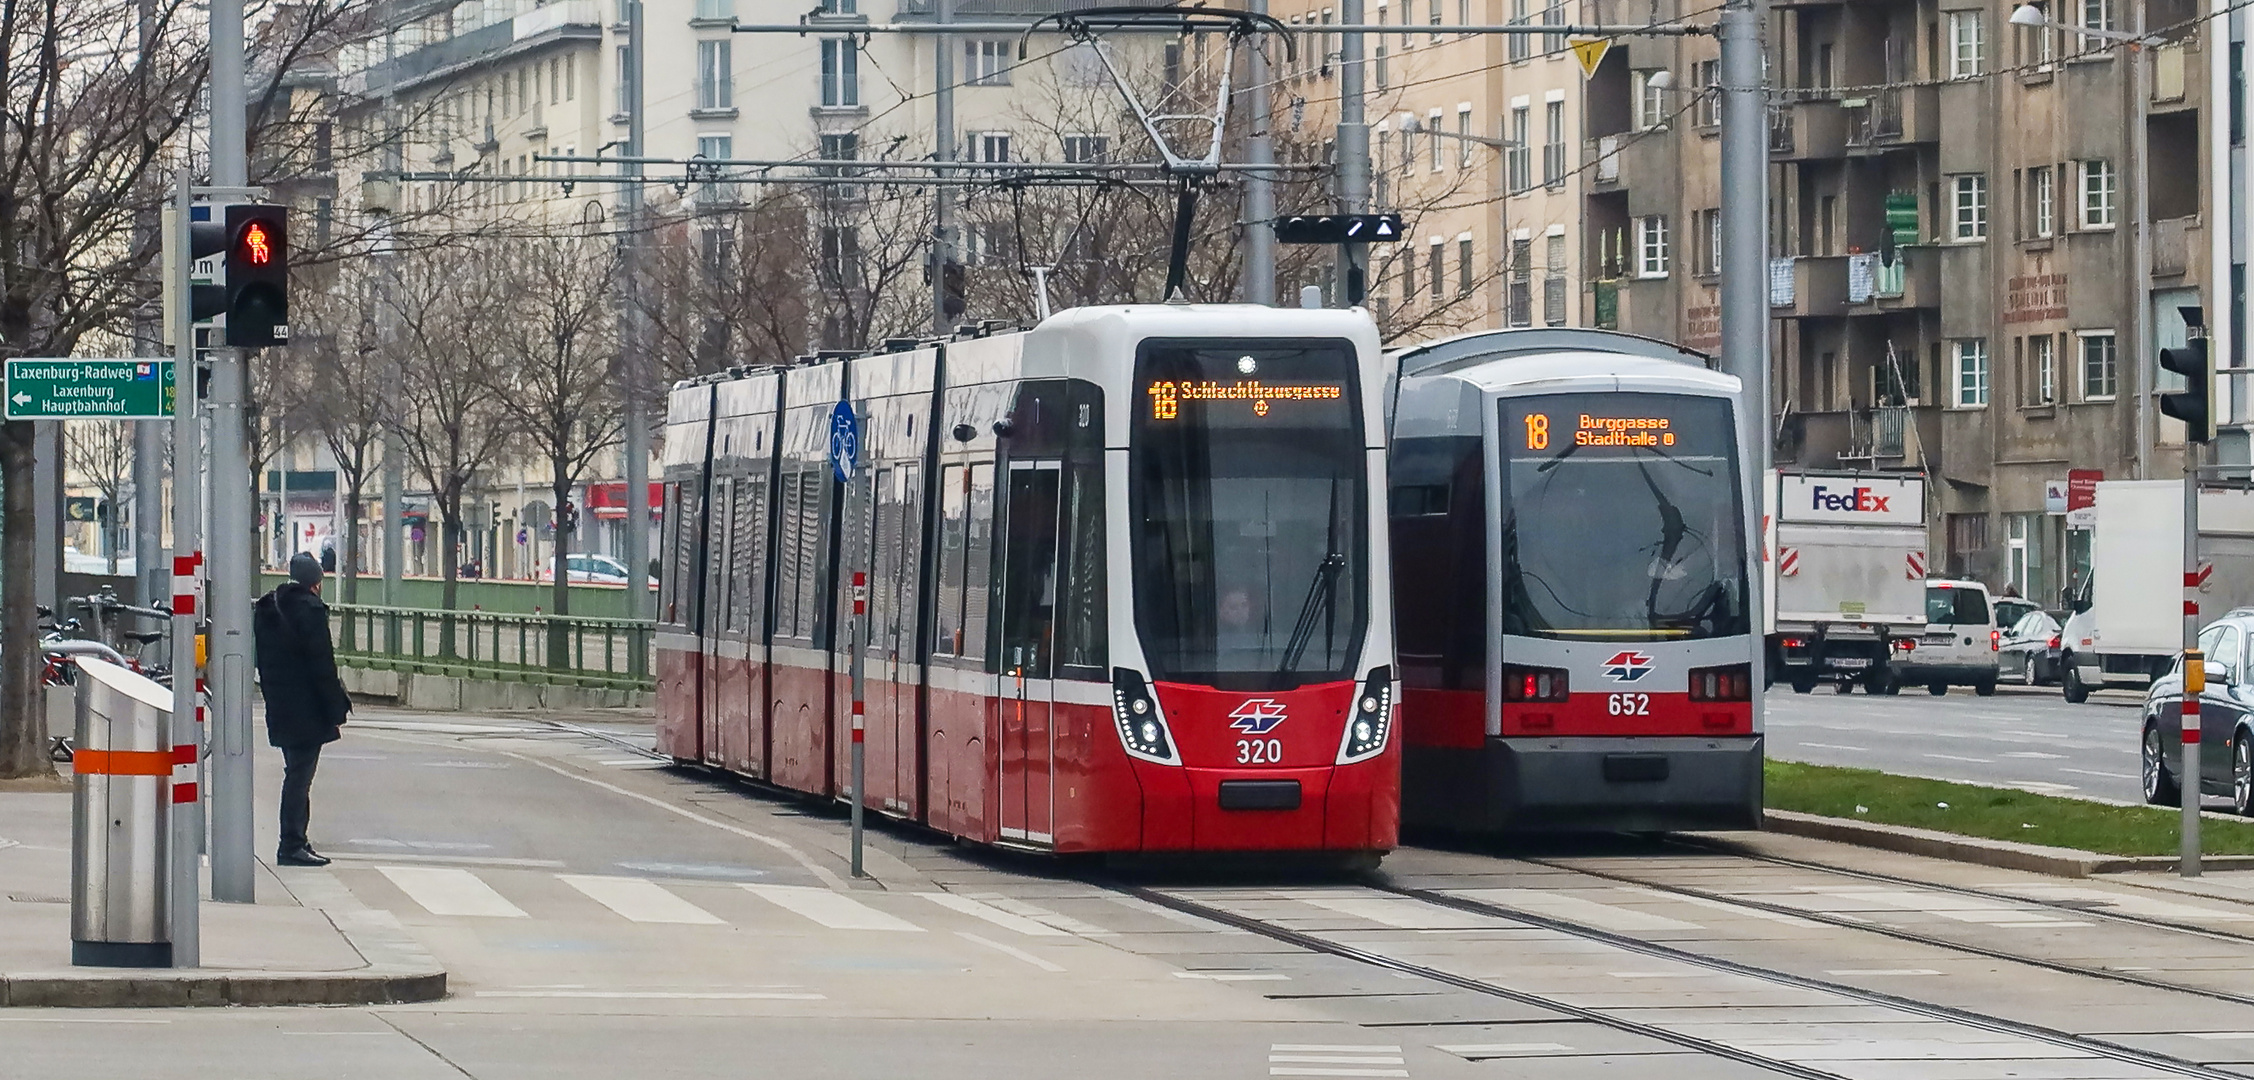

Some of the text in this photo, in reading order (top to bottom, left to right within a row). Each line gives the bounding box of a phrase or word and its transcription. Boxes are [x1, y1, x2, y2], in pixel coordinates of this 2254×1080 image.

[274, 326, 288, 337] 44
[14, 364, 133, 382] Laxenburg-Radweg
[53, 384, 114, 399] Laxenburg
[1148, 381, 1177, 419] 18
[42, 399, 126, 415] Hauptbahnhof
[1525, 413, 1549, 450] 18
[1580, 414, 1669, 431] Burggasse
[1576, 432, 1658, 446] Stadthalle
[1813, 485, 1890, 513] FedEx
[1608, 693, 1650, 716] 652
[1236, 739, 1281, 764] 320
